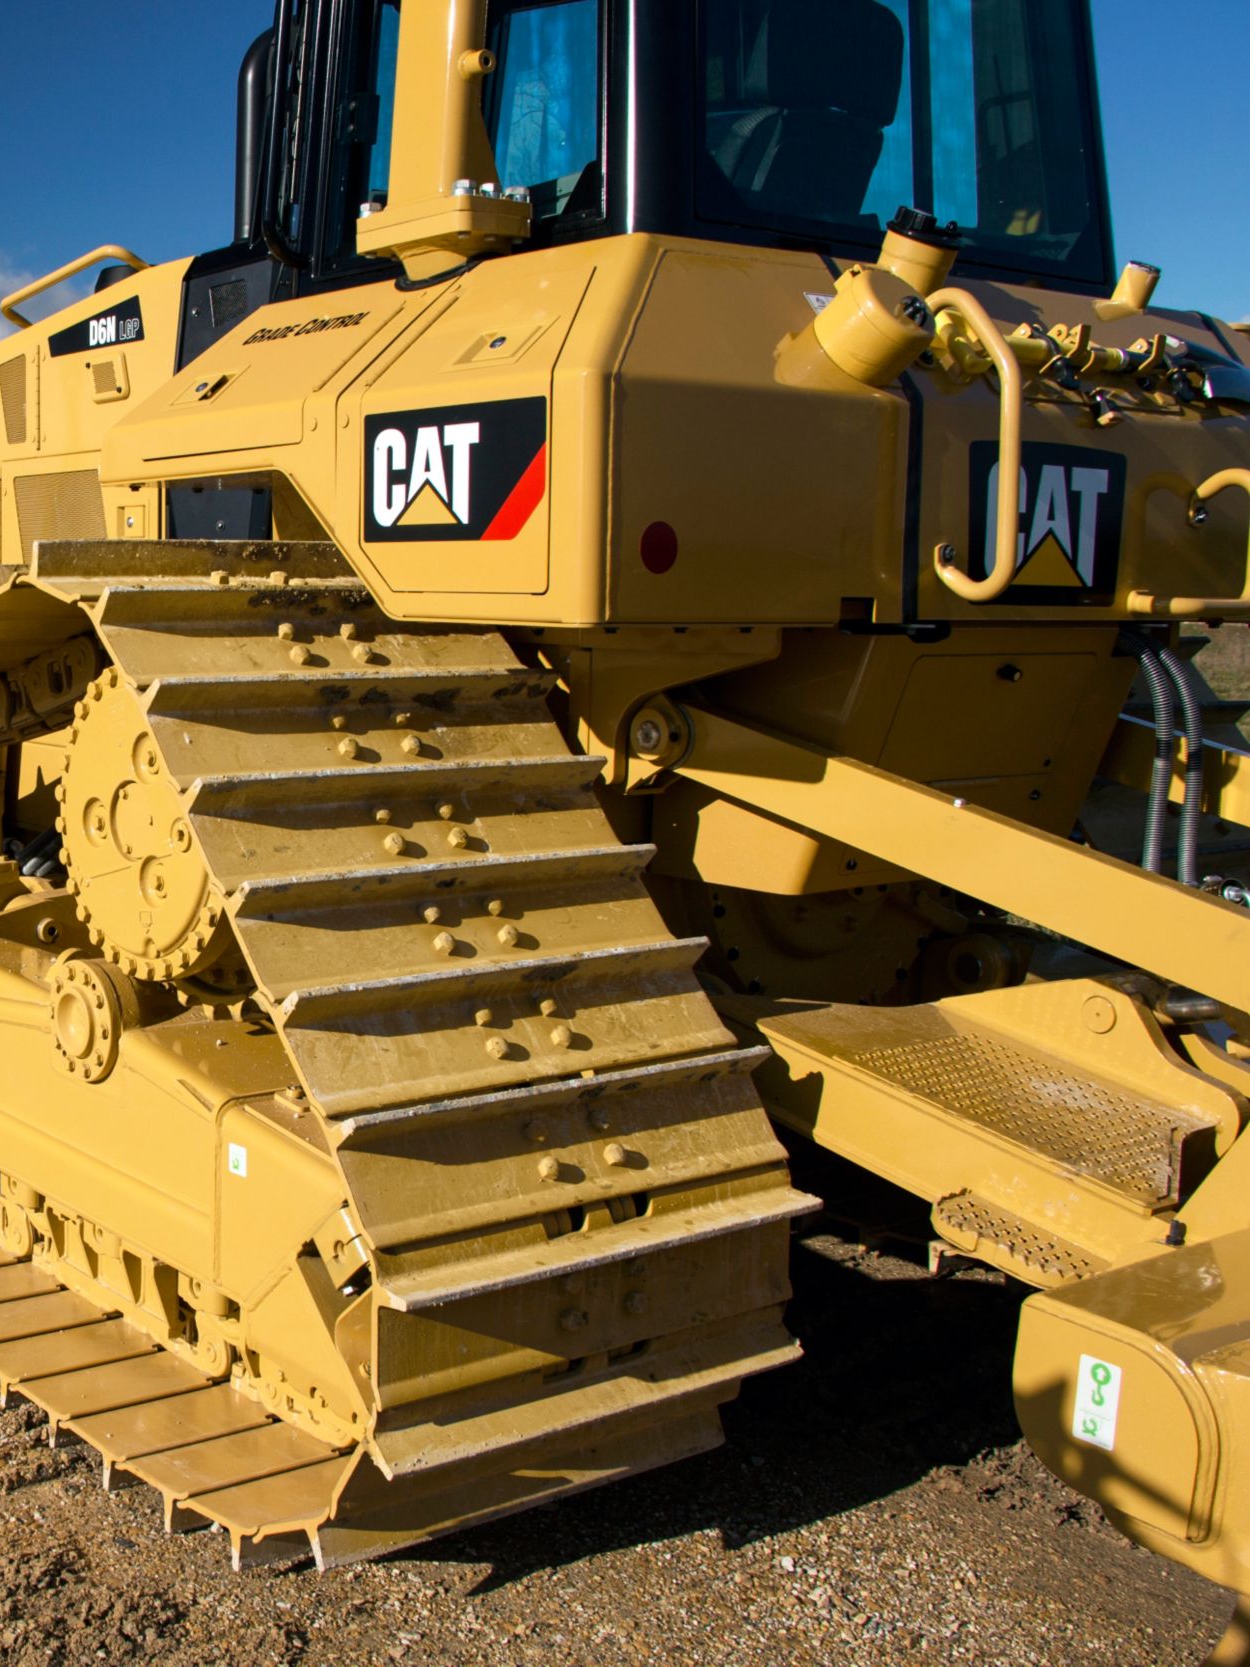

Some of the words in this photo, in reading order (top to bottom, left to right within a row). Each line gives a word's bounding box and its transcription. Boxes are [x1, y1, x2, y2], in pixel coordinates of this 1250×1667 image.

[89, 315, 116, 346] D6N
[119, 318, 139, 340] LGP
[242, 323, 302, 346] GRADE
[293, 310, 371, 337] CONTROL
[373, 421, 480, 528] CAT
